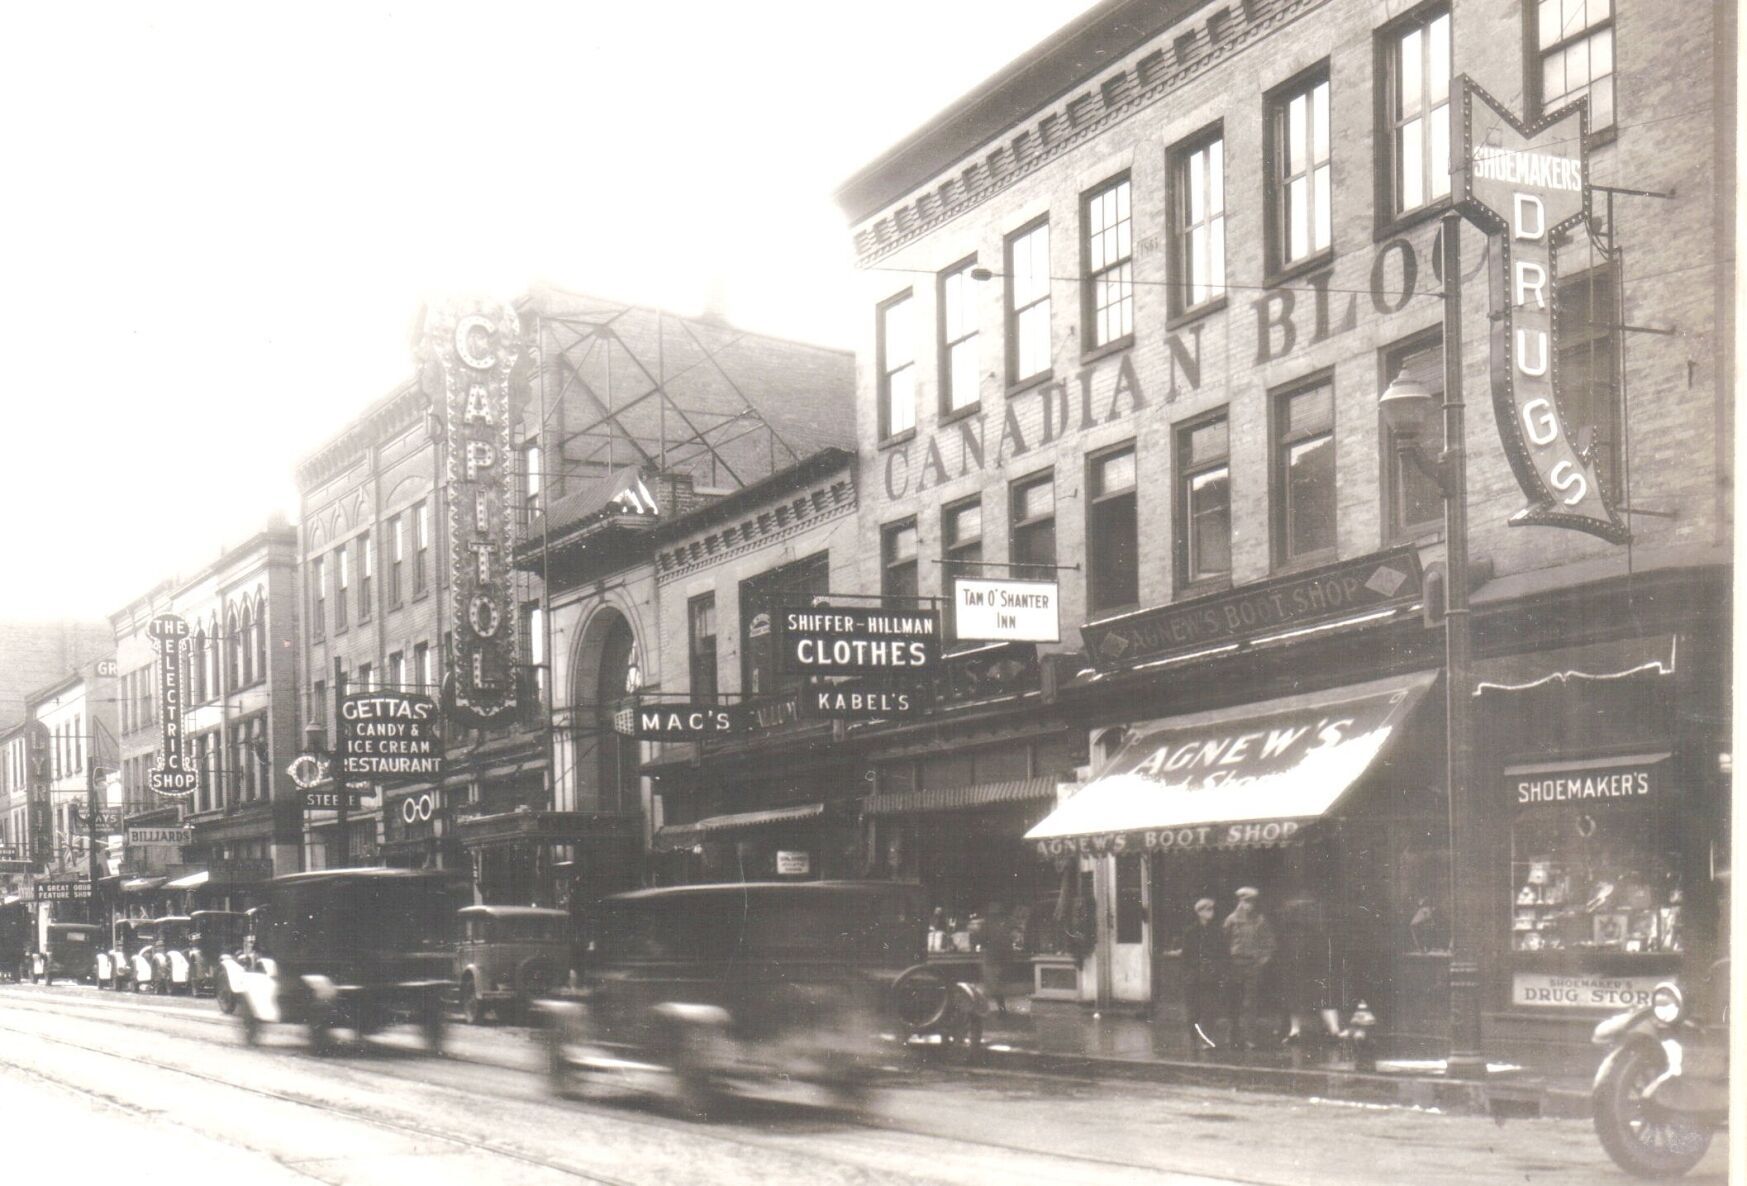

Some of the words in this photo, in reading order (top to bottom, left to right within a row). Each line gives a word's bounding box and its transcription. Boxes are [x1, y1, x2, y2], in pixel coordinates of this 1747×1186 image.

[1473, 146, 1581, 191] SHOEMAKERS
[1513, 192, 1588, 506] DRUGS
[884, 324, 1206, 502] CANADIAN
[454, 315, 501, 690] CAPITOL
[1225, 599, 1285, 629] BOOT
[1297, 577, 1359, 613] SHOP
[155, 620, 185, 635] THE
[797, 639, 926, 666] CLOTHES
[165, 640, 178, 769] ELECTRIC
[818, 692, 909, 710] KABEL'S
[357, 723, 405, 736] CANDY
[411, 724, 419, 736] &
[641, 710, 731, 731] MAC'S
[348, 741, 373, 753] ICE
[379, 741, 430, 753] CREAM
[1128, 718, 1355, 775] AGNEW'S
[153, 774, 195, 788] SHOP
[1518, 772, 1649, 803] SHOEMAKER'S
[131, 831, 191, 842] BILLIARDS
[1036, 832, 1127, 855] AGNEW'S
[1144, 828, 1210, 849] BOOT
[1226, 821, 1298, 844] SHOP
[1525, 987, 1579, 1002] DRUG
[1591, 989, 1655, 1005] STOR
